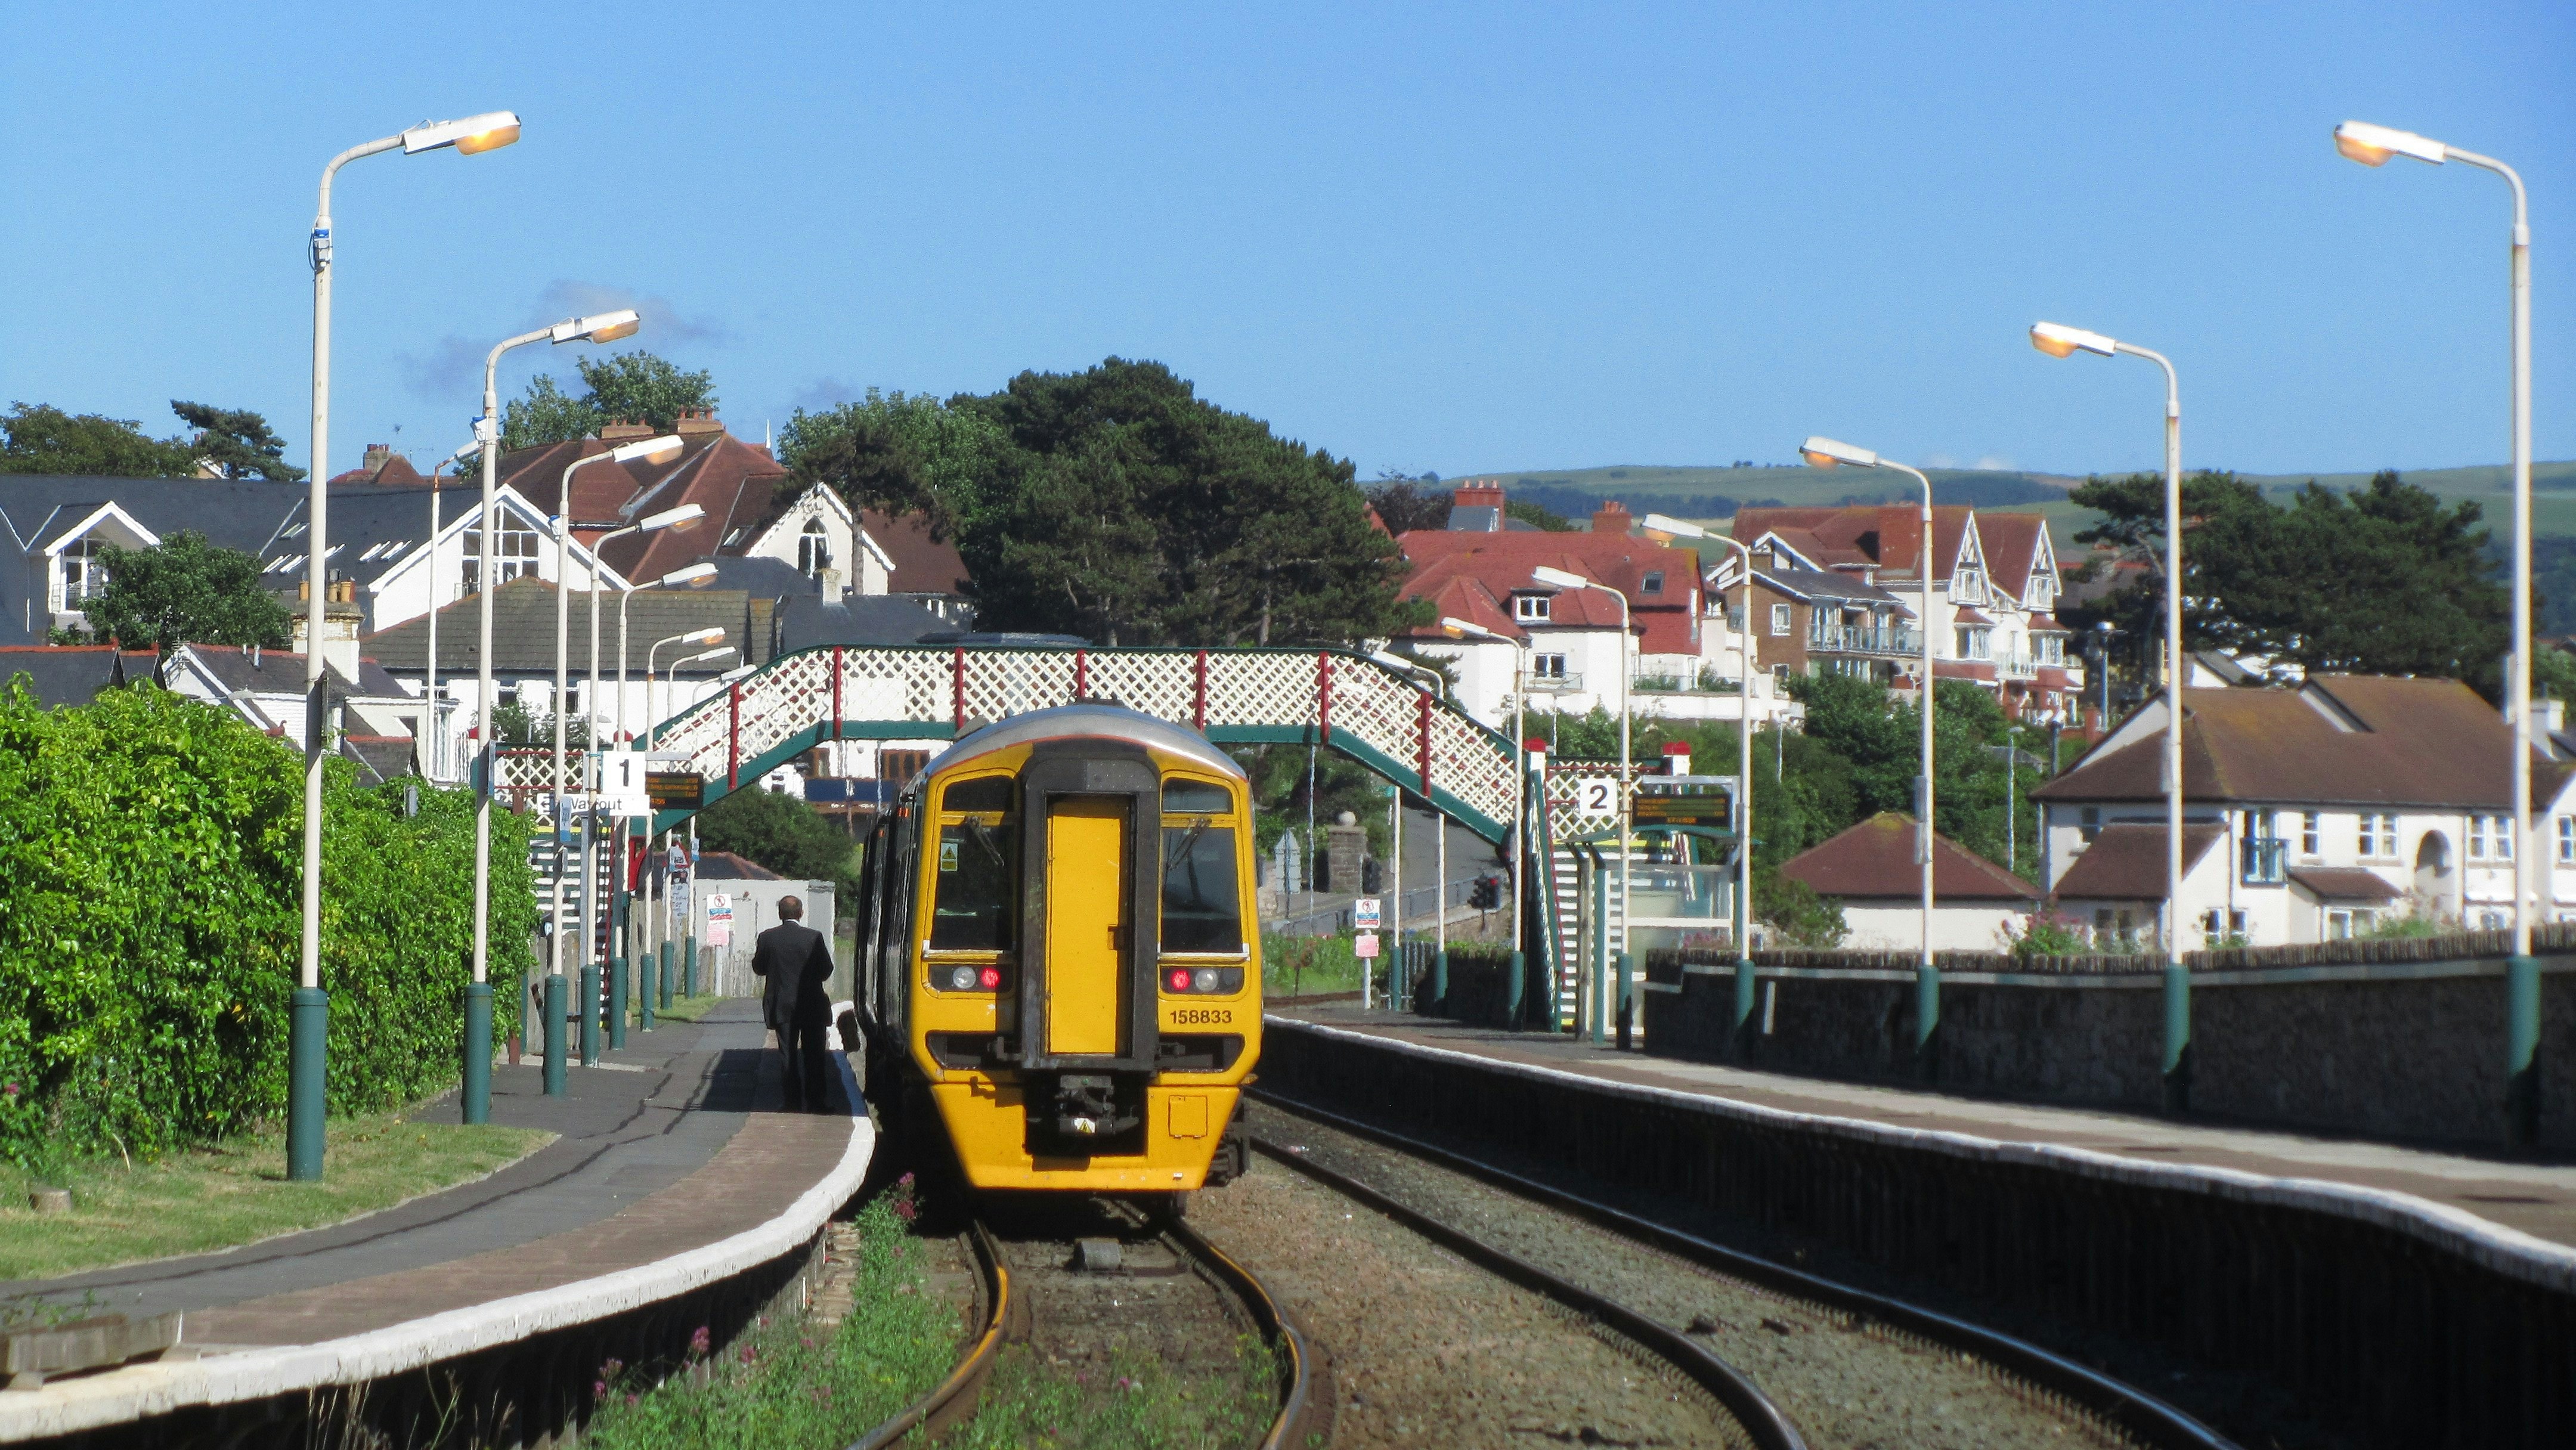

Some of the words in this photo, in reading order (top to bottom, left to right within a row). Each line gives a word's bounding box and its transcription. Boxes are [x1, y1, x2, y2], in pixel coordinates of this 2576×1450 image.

[619, 758, 629, 787] 1
[599, 798, 622, 810] out
[1590, 785, 1608, 809] 2
[1170, 1009, 1232, 1024] 158833
